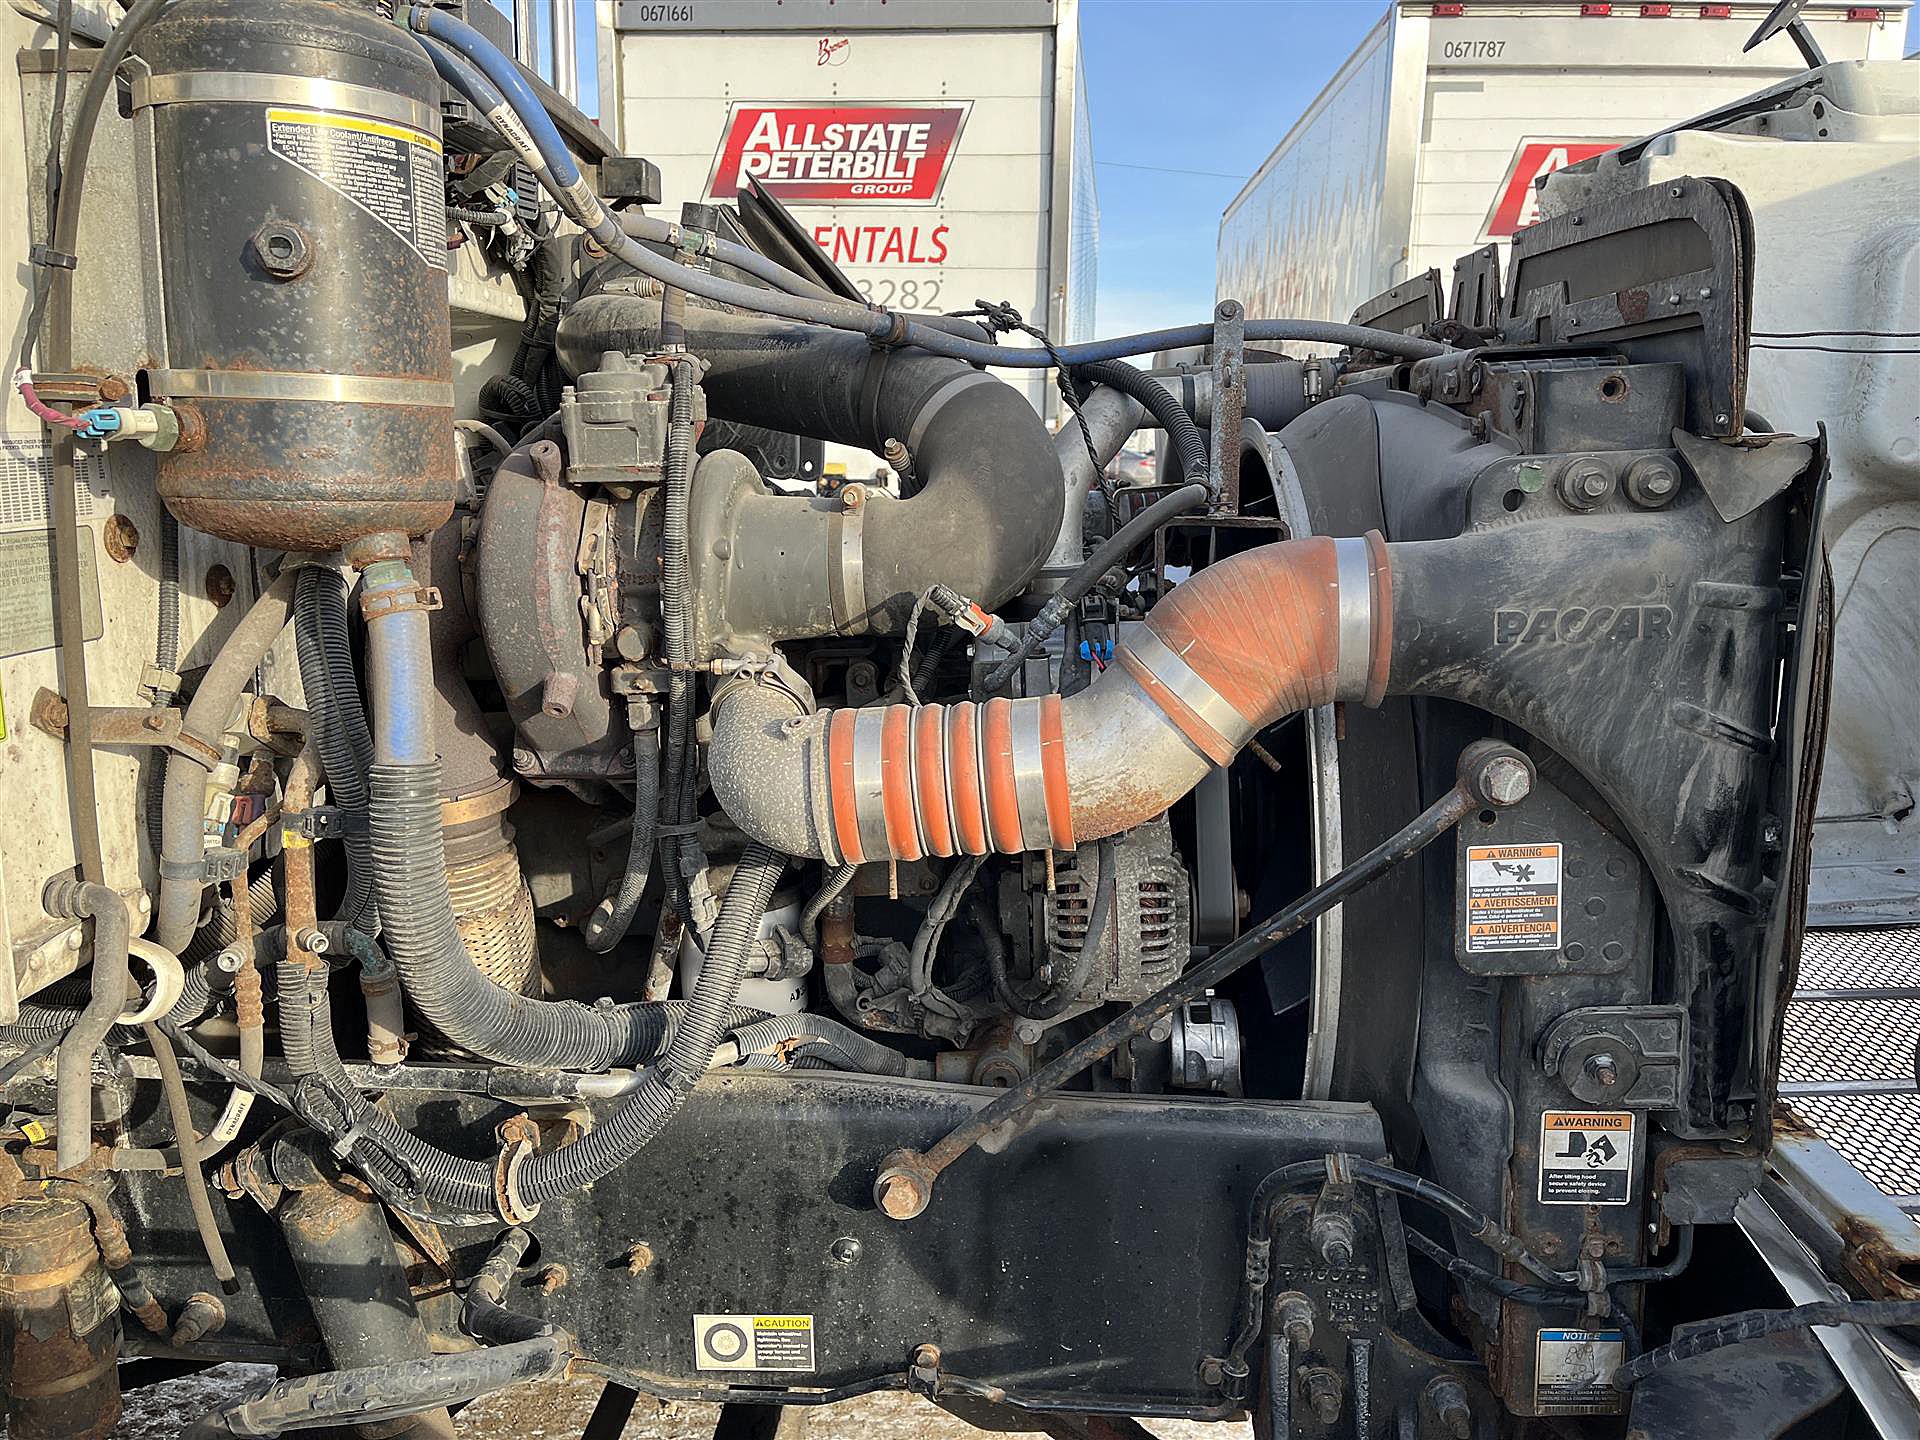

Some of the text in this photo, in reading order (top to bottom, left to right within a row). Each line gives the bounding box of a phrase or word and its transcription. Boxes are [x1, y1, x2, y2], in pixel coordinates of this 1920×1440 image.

[640, 5, 694, 22] 0671661
[1443, 40, 1506, 59] 0671787
[271, 123, 311, 134] Extended
[494, 114, 532, 153] DYNACRAFT
[743, 112, 931, 151] ALLSTATE
[736, 151, 925, 189] PETERBILT
[850, 183, 913, 194] GROUP
[808, 225, 950, 264] ENTALS
[1493, 603, 1675, 646] PACCAR
[1498, 848, 1542, 858] WARNING
[1483, 896, 1556, 908] AVERTISSEMENT
[1488, 923, 1552, 934] ADVERTENCIA
[1564, 1118, 1623, 1128] WARNING
[763, 1319, 809, 1328] CAUTION
[1562, 1332, 1602, 1341] NOTICE
